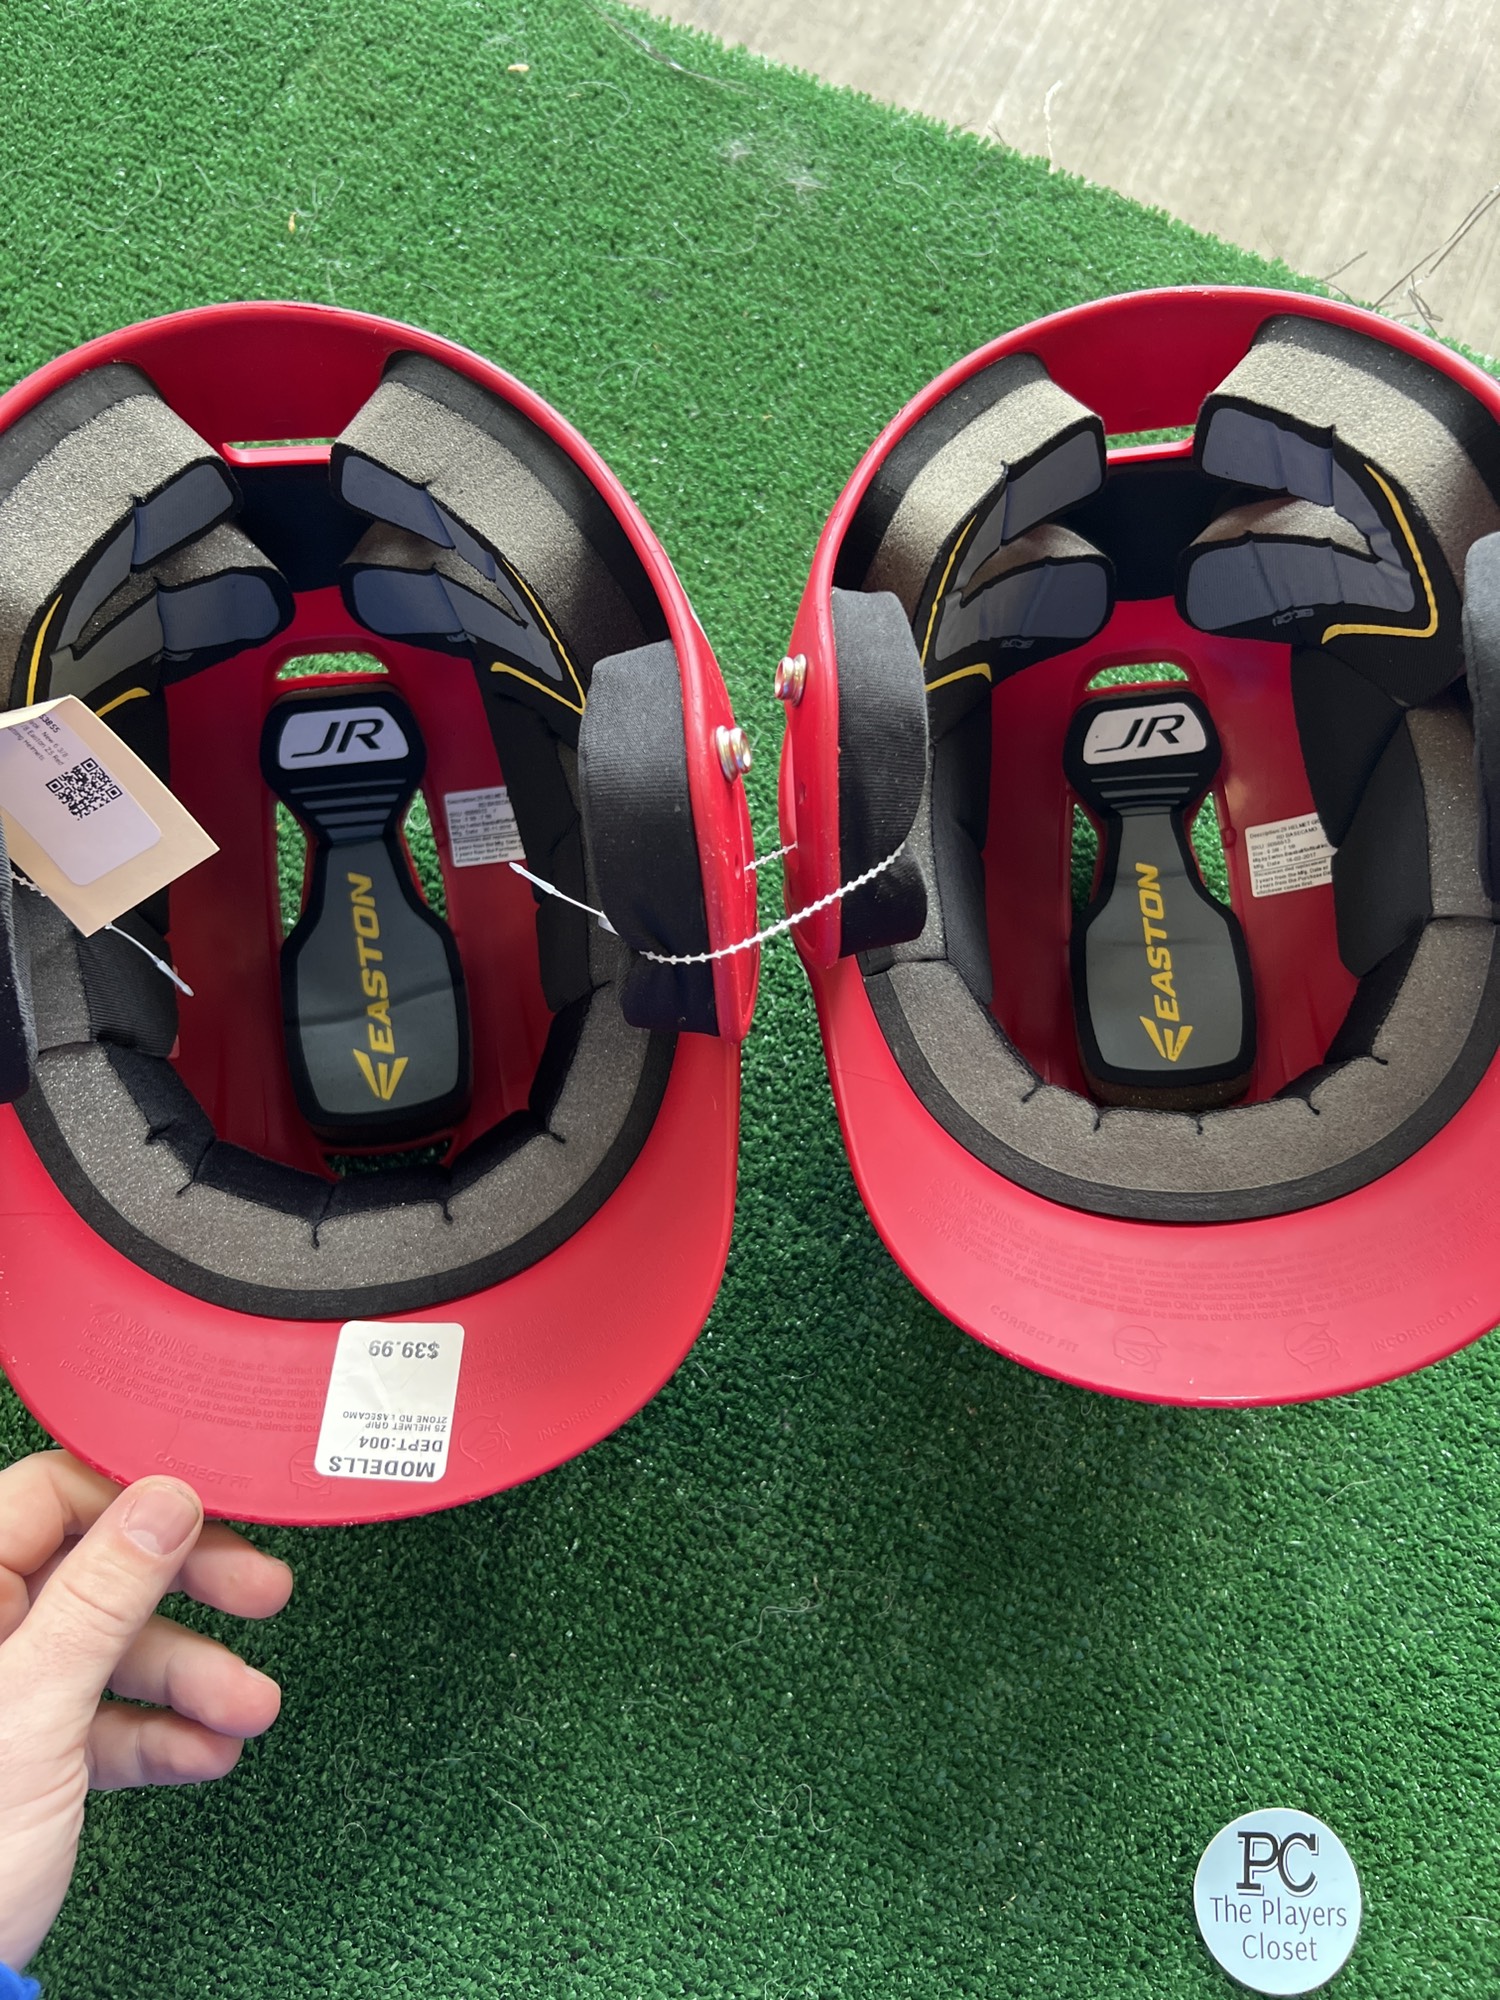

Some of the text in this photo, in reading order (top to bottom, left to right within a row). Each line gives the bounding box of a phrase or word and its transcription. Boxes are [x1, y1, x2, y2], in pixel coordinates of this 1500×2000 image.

[291, 717, 385, 758] JR
[1094, 714, 1186, 754] JR
[1135, 862, 1180, 1023] EASTON
[347, 872, 395, 1055] EASTON
[126, 1317, 198, 1359] WARNING
[990, 1304, 1056, 1345] CORRECT
[368, 1340, 440, 1359] $39.99
[365, 1421, 389, 1430] GRIP
[391, 1422, 431, 1432] HELMET
[399, 1414, 413, 1422] RD
[359, 1435, 444, 1453] DEPT:004
[155, 1451, 228, 1485] CORRECT
[328, 1455, 436, 1478] MODELLS
[1236, 1831, 1320, 1898] PC
[1209, 1894, 1348, 1935] The Players
[1242, 1932, 1318, 1962] Closet
